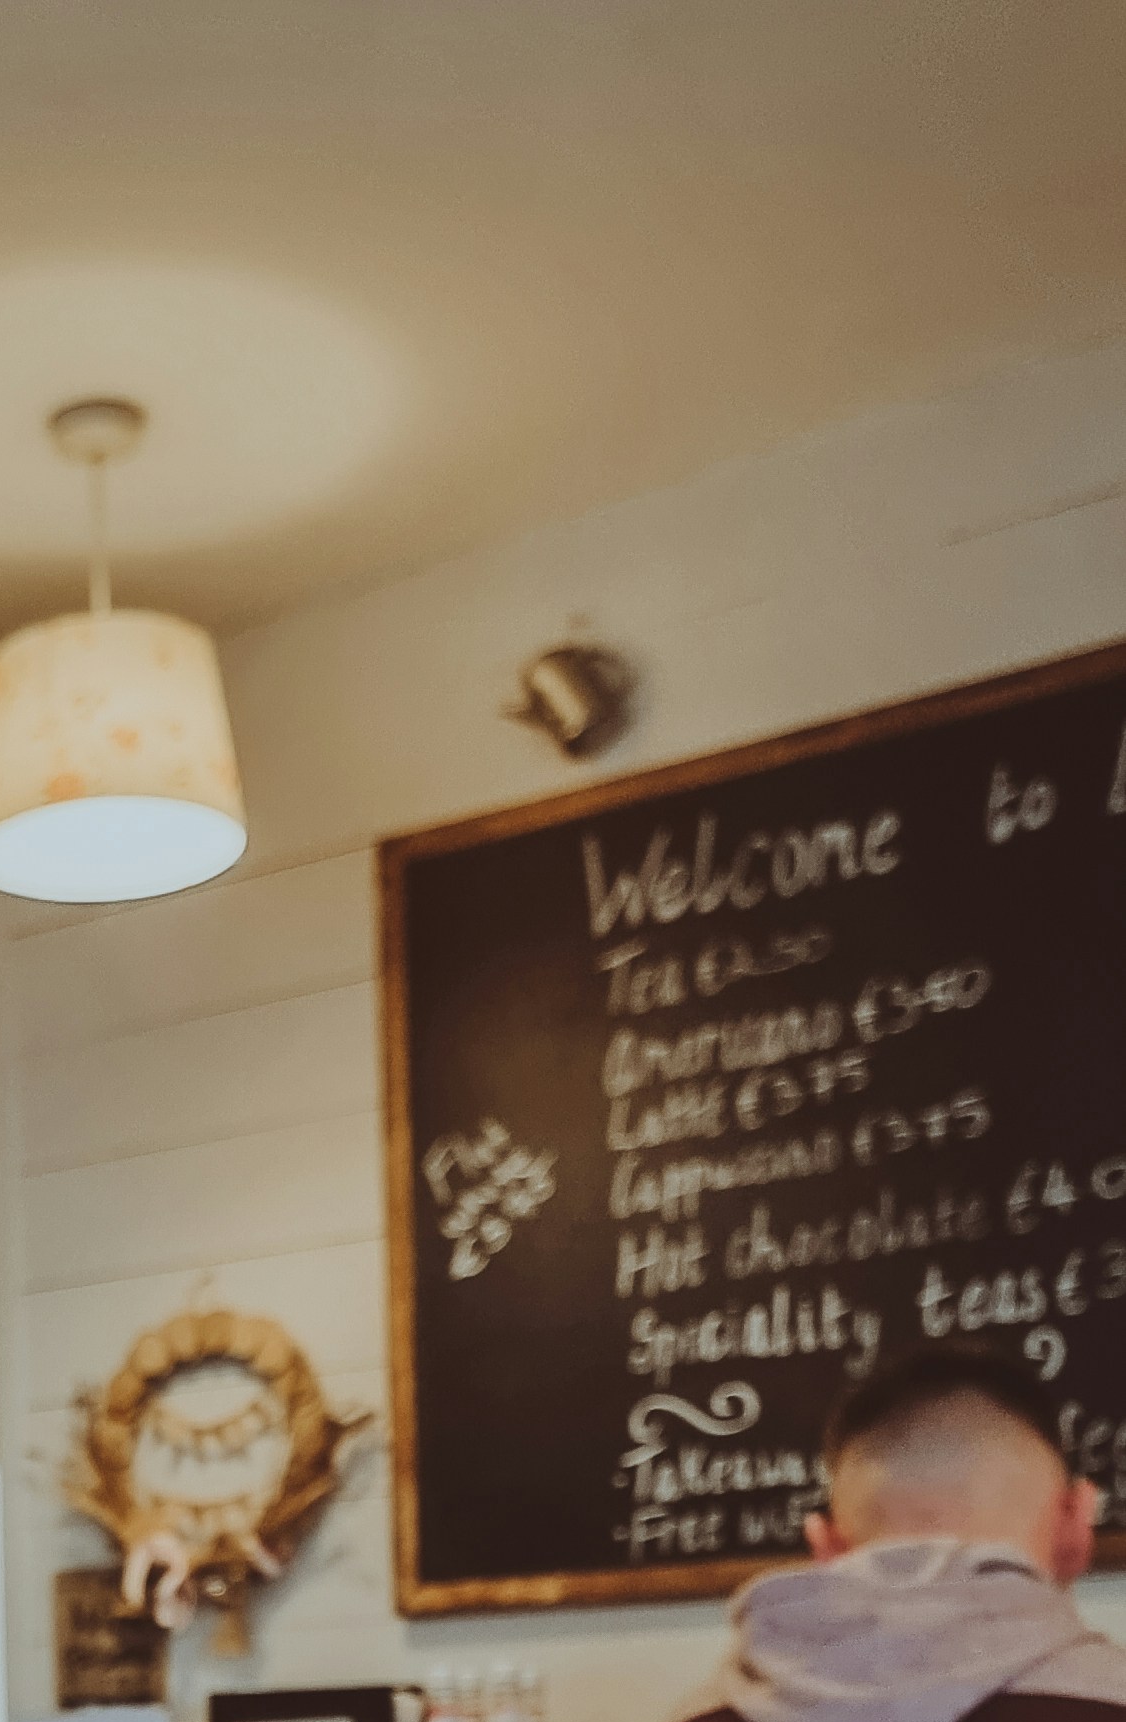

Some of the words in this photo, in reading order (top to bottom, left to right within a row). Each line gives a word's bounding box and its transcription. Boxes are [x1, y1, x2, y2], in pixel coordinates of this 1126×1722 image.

[582, 808, 901, 938] Welcome
[987, 763, 1057, 845] to
[596, 938, 687, 1014] Tea
[615, 1223, 710, 1298] Hot
[725, 1187, 988, 1279] chocolate
[917, 1263, 1047, 1338] teas
